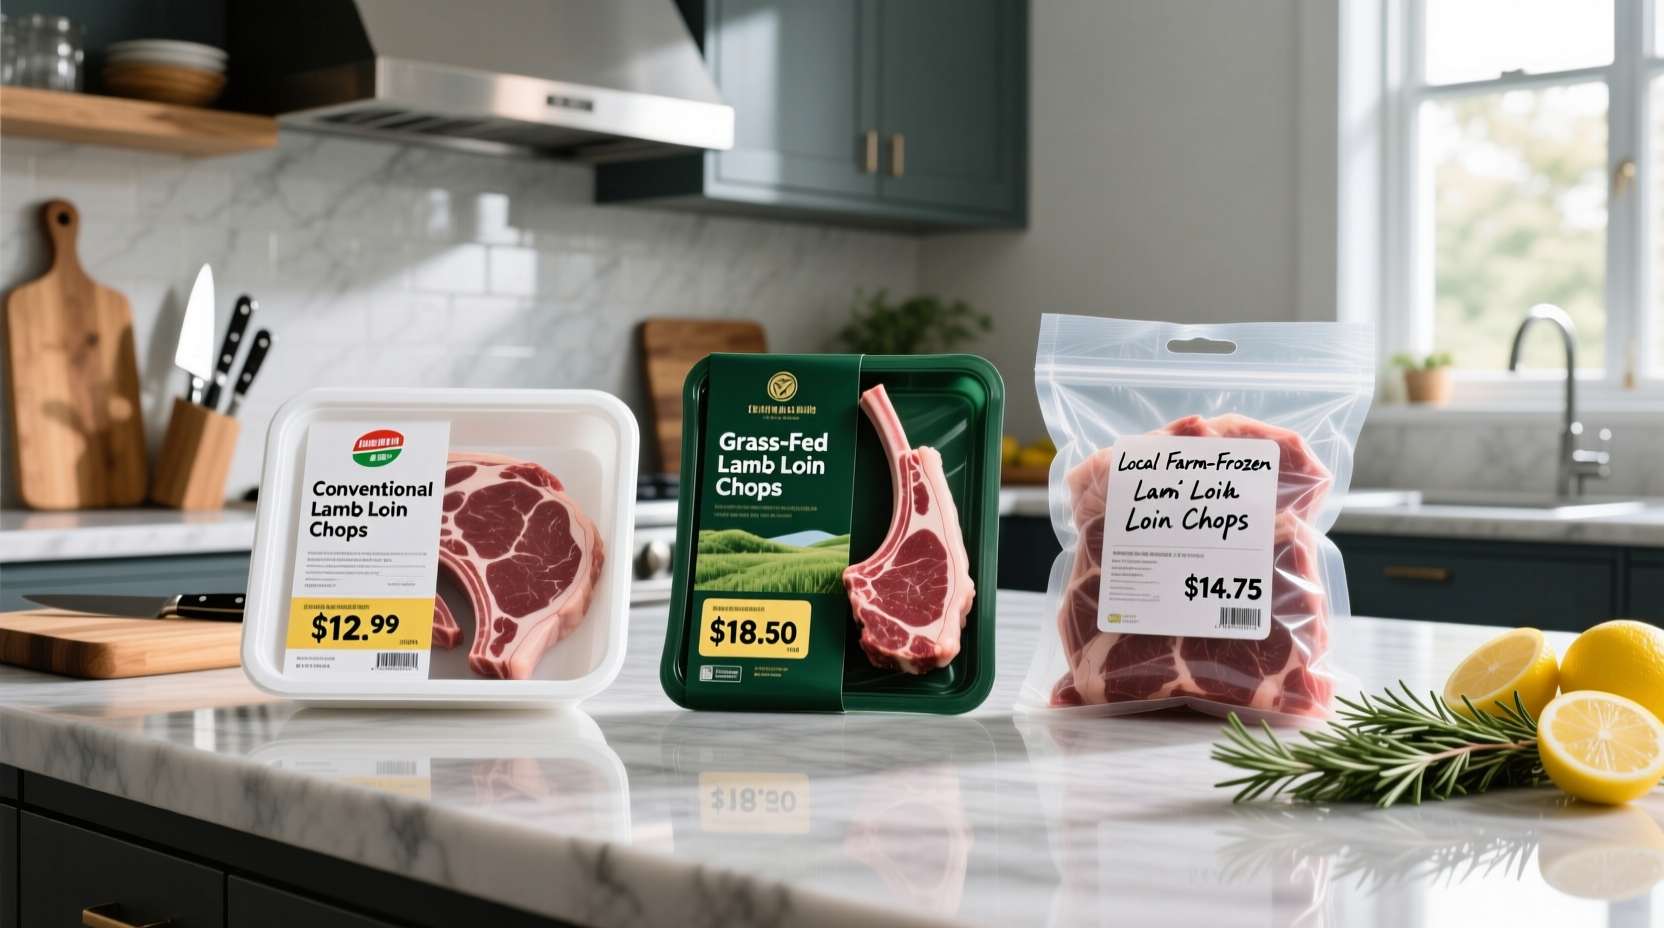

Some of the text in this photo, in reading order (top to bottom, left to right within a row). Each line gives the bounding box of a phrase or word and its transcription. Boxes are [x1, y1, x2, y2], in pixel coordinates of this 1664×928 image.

[719, 432, 828, 452] Grass-Fed
[718, 455, 825, 474] Lamb Loin
[1118, 451, 1272, 472] Local Farm-Frozen
[312, 481, 433, 497] Conventional
[715, 477, 782, 501] Chops
[311, 501, 408, 517] Lamb Loin
[309, 521, 368, 542] Chops
[1125, 506, 1249, 540] Loin Chops
[1184, 573, 1262, 601] $14.75
[311, 612, 400, 643] $12.99
[709, 616, 797, 647] $18.50
